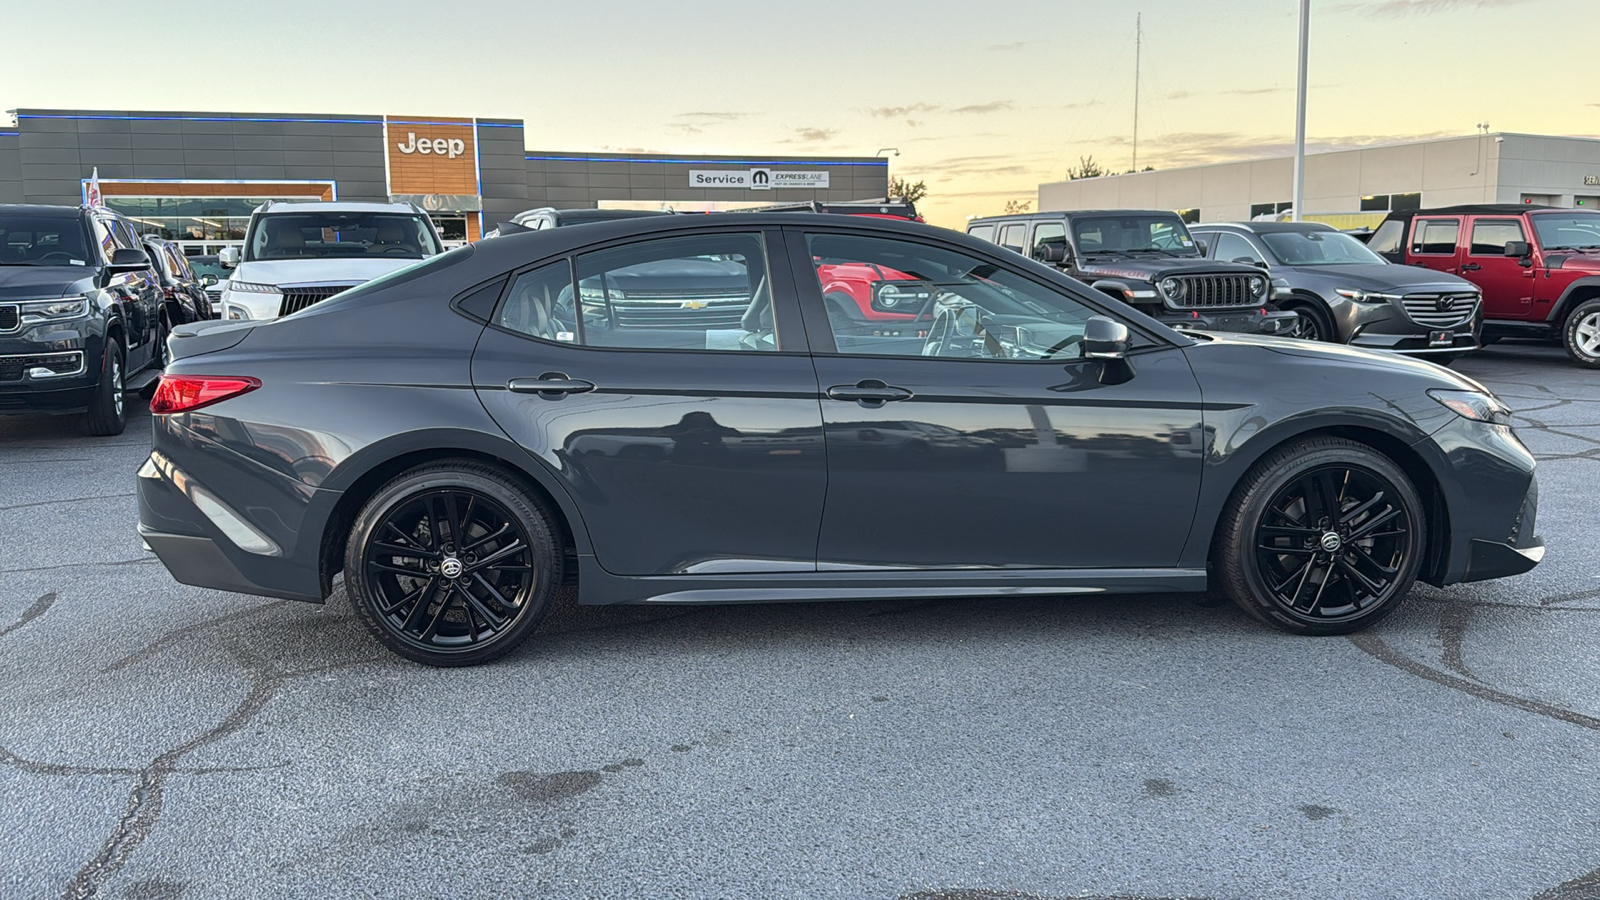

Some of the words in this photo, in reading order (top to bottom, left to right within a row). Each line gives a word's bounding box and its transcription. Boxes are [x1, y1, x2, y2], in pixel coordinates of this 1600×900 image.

[397, 132, 465, 159] Jeep
[696, 174, 744, 184] Service
[1094, 268, 1146, 278] RUBICON
[351, 575, 390, 639] TURANZA
